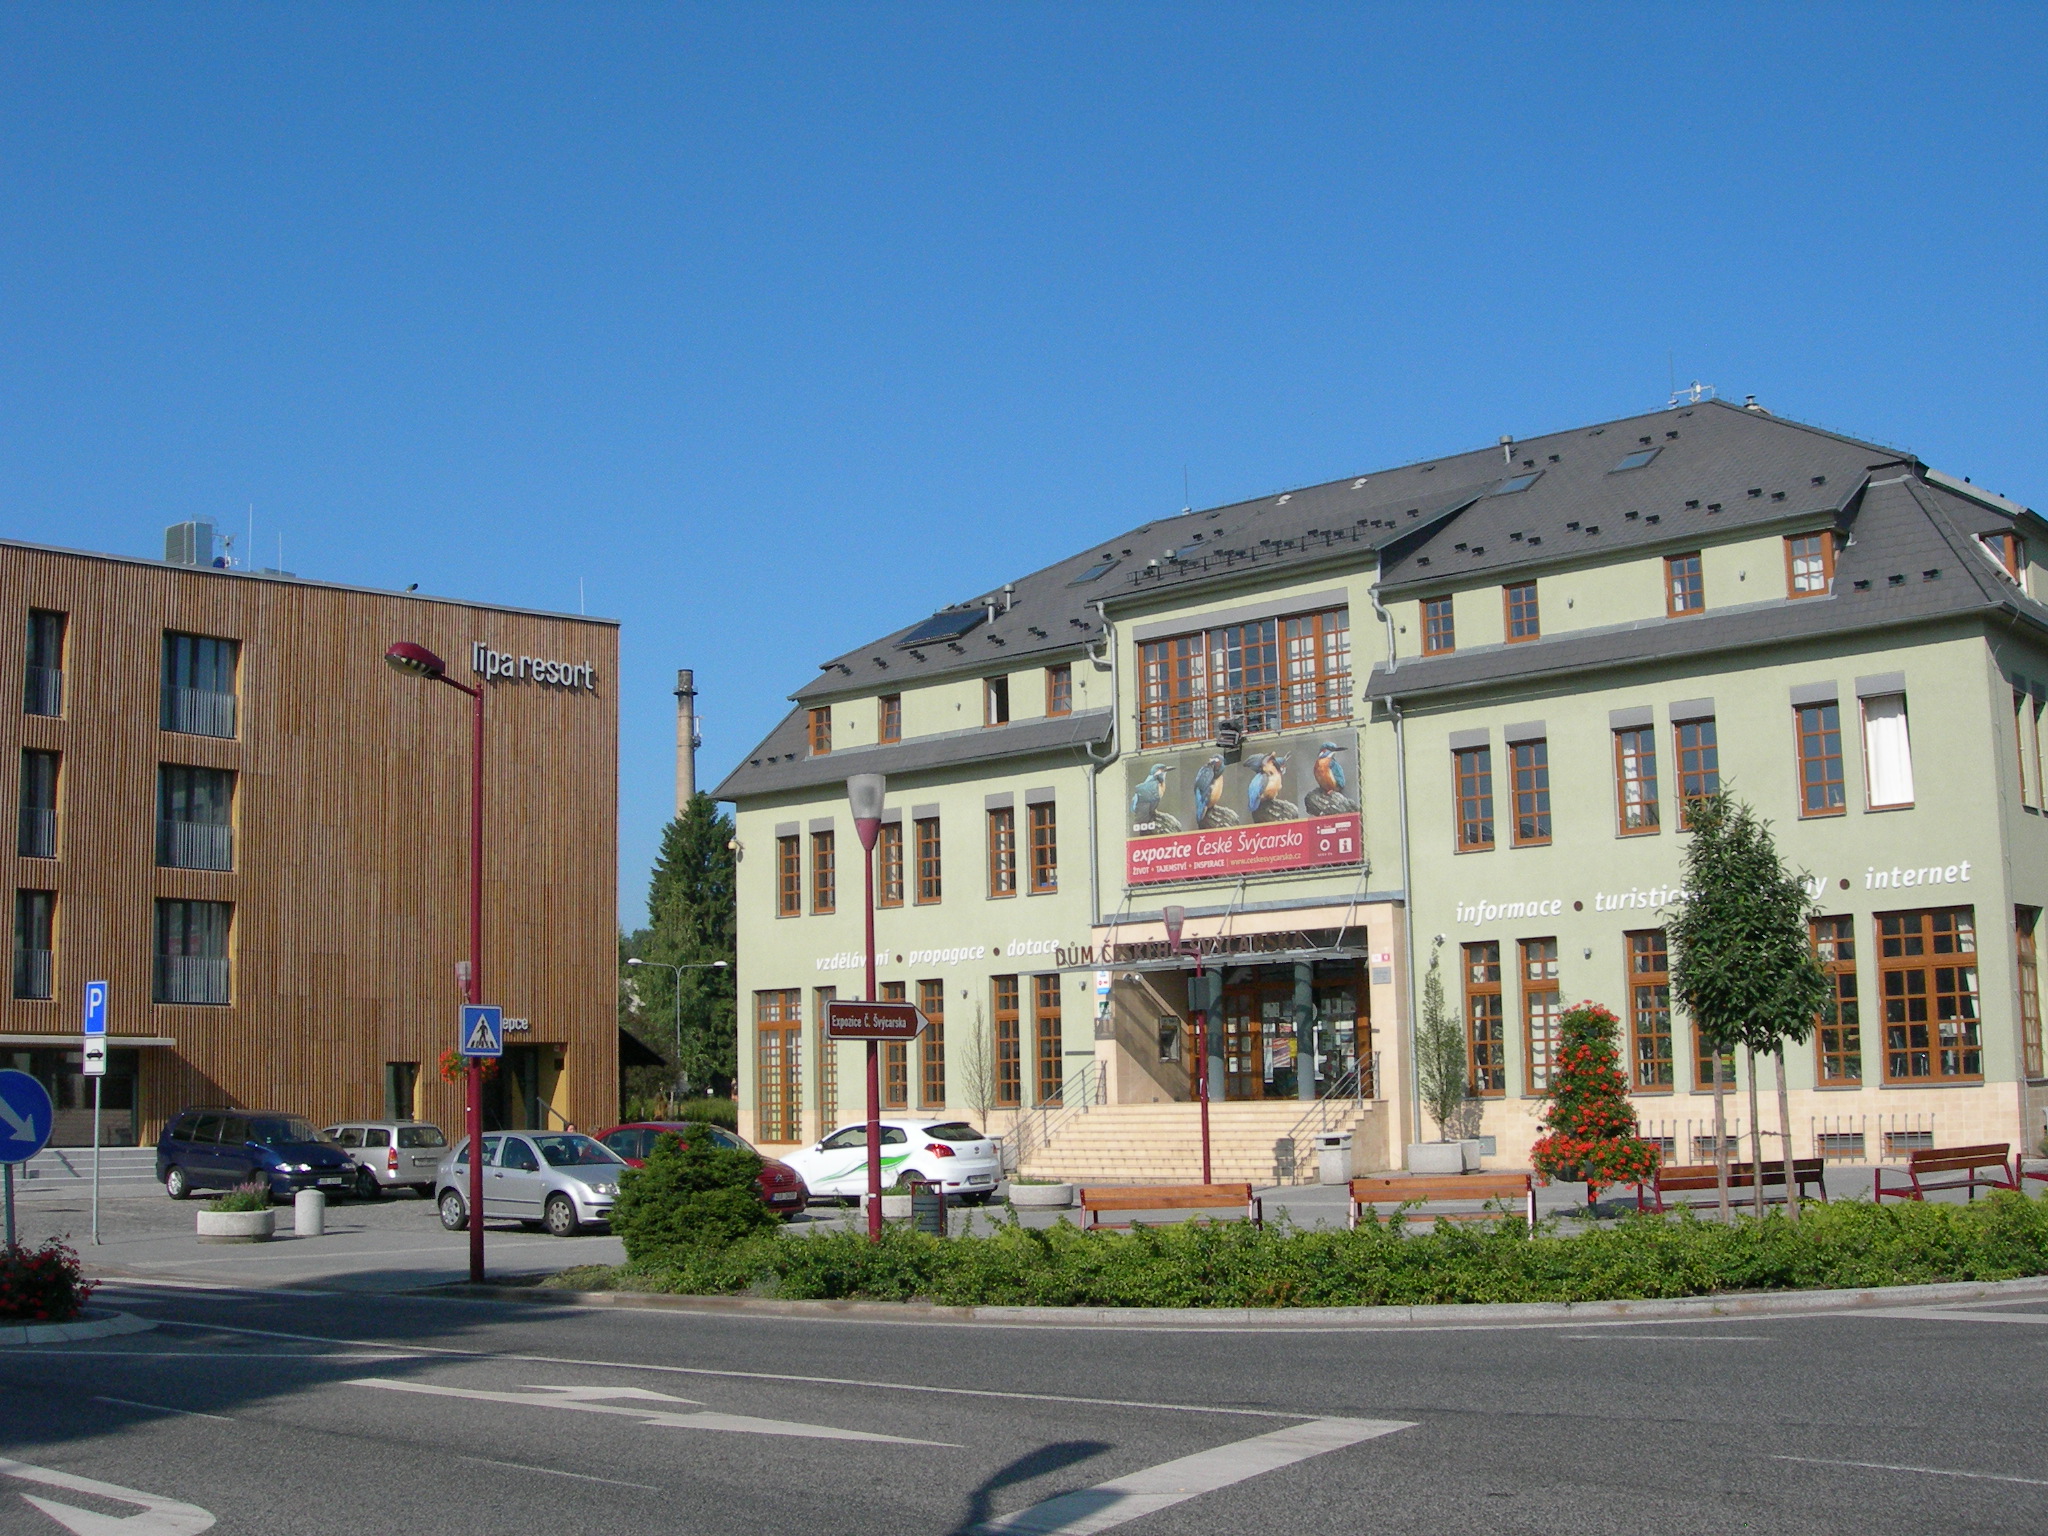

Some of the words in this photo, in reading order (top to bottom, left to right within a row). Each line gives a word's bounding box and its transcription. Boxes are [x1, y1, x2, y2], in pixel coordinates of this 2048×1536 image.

[519, 655, 594, 690] resort
[1132, 841, 1192, 866] expozice
[1196, 835, 1233, 856] České
[1237, 828, 1303, 855] Švýcarsko
[1194, 859, 1225, 870] INSPIRACE
[1865, 859, 1972, 890] internet
[1456, 899, 1562, 927] informace
[909, 945, 985, 967] propagace
[1007, 938, 1060, 957] dotace
[1056, 941, 1094, 966] DŮM
[831, 1015, 862, 1030] Expozice
[873, 1013, 907, 1030] Švýcarska
